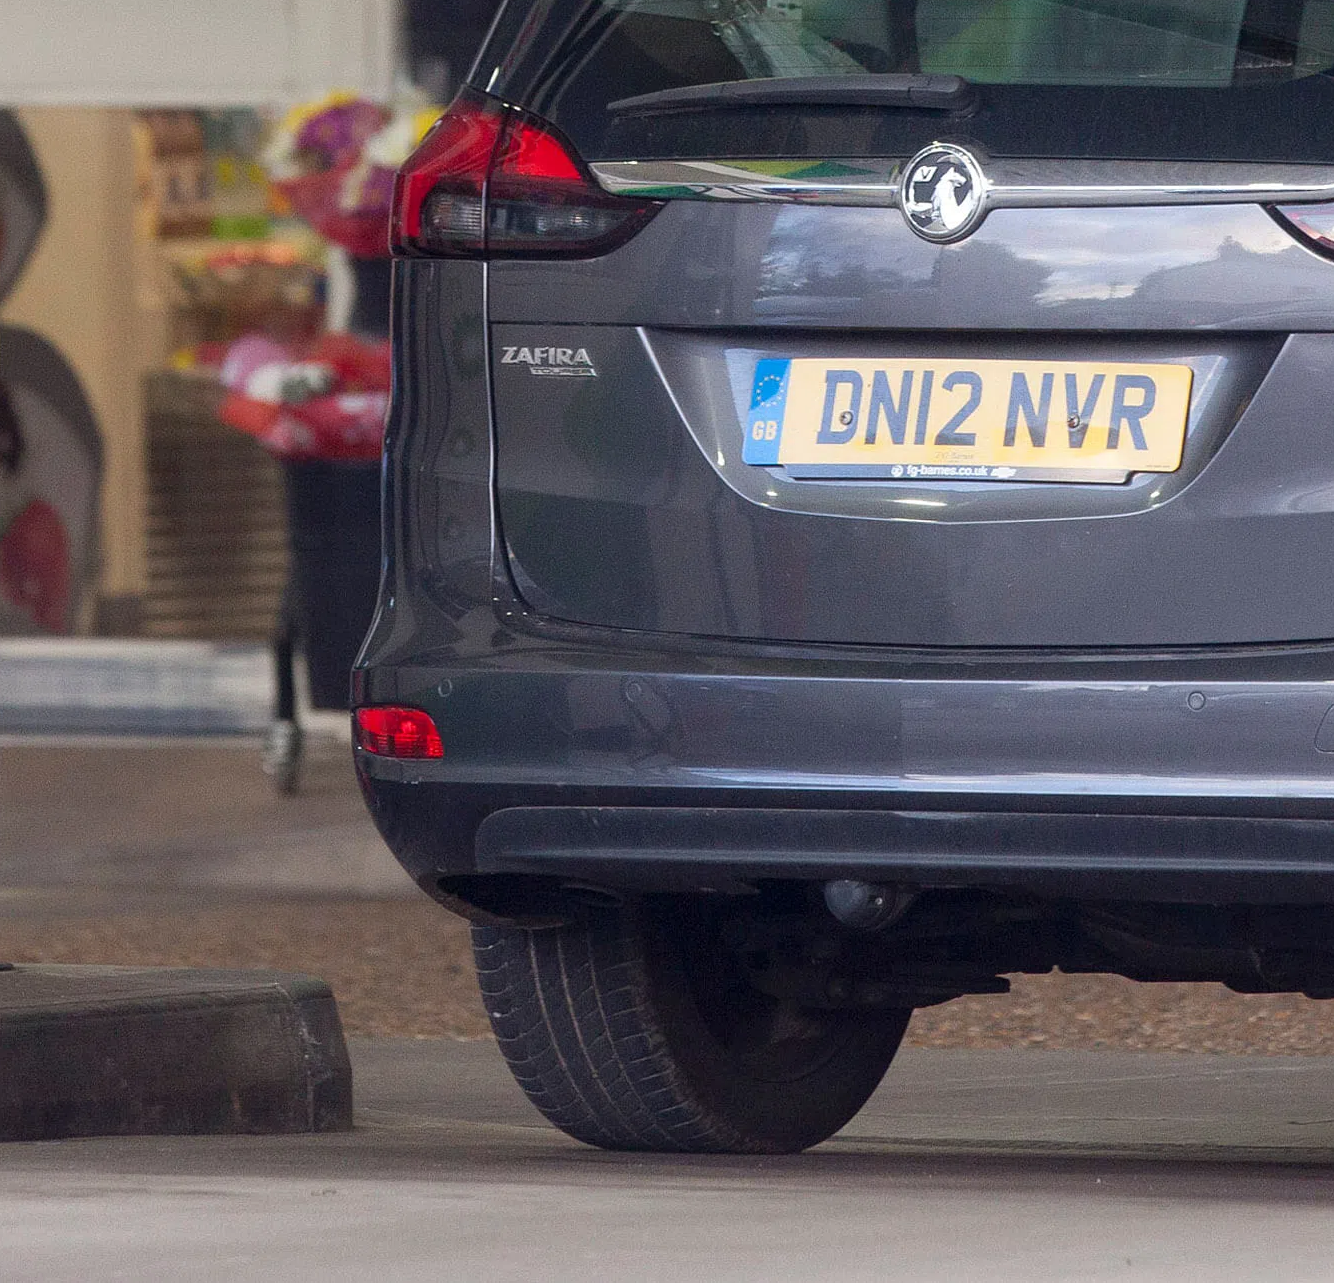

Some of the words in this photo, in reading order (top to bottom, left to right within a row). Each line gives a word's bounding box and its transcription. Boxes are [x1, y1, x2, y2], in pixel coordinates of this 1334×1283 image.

[500, 346, 594, 366] ZAFIRA
[816, 369, 983, 446] DN12
[1003, 372, 1157, 451] NVR
[751, 420, 777, 441] GB
